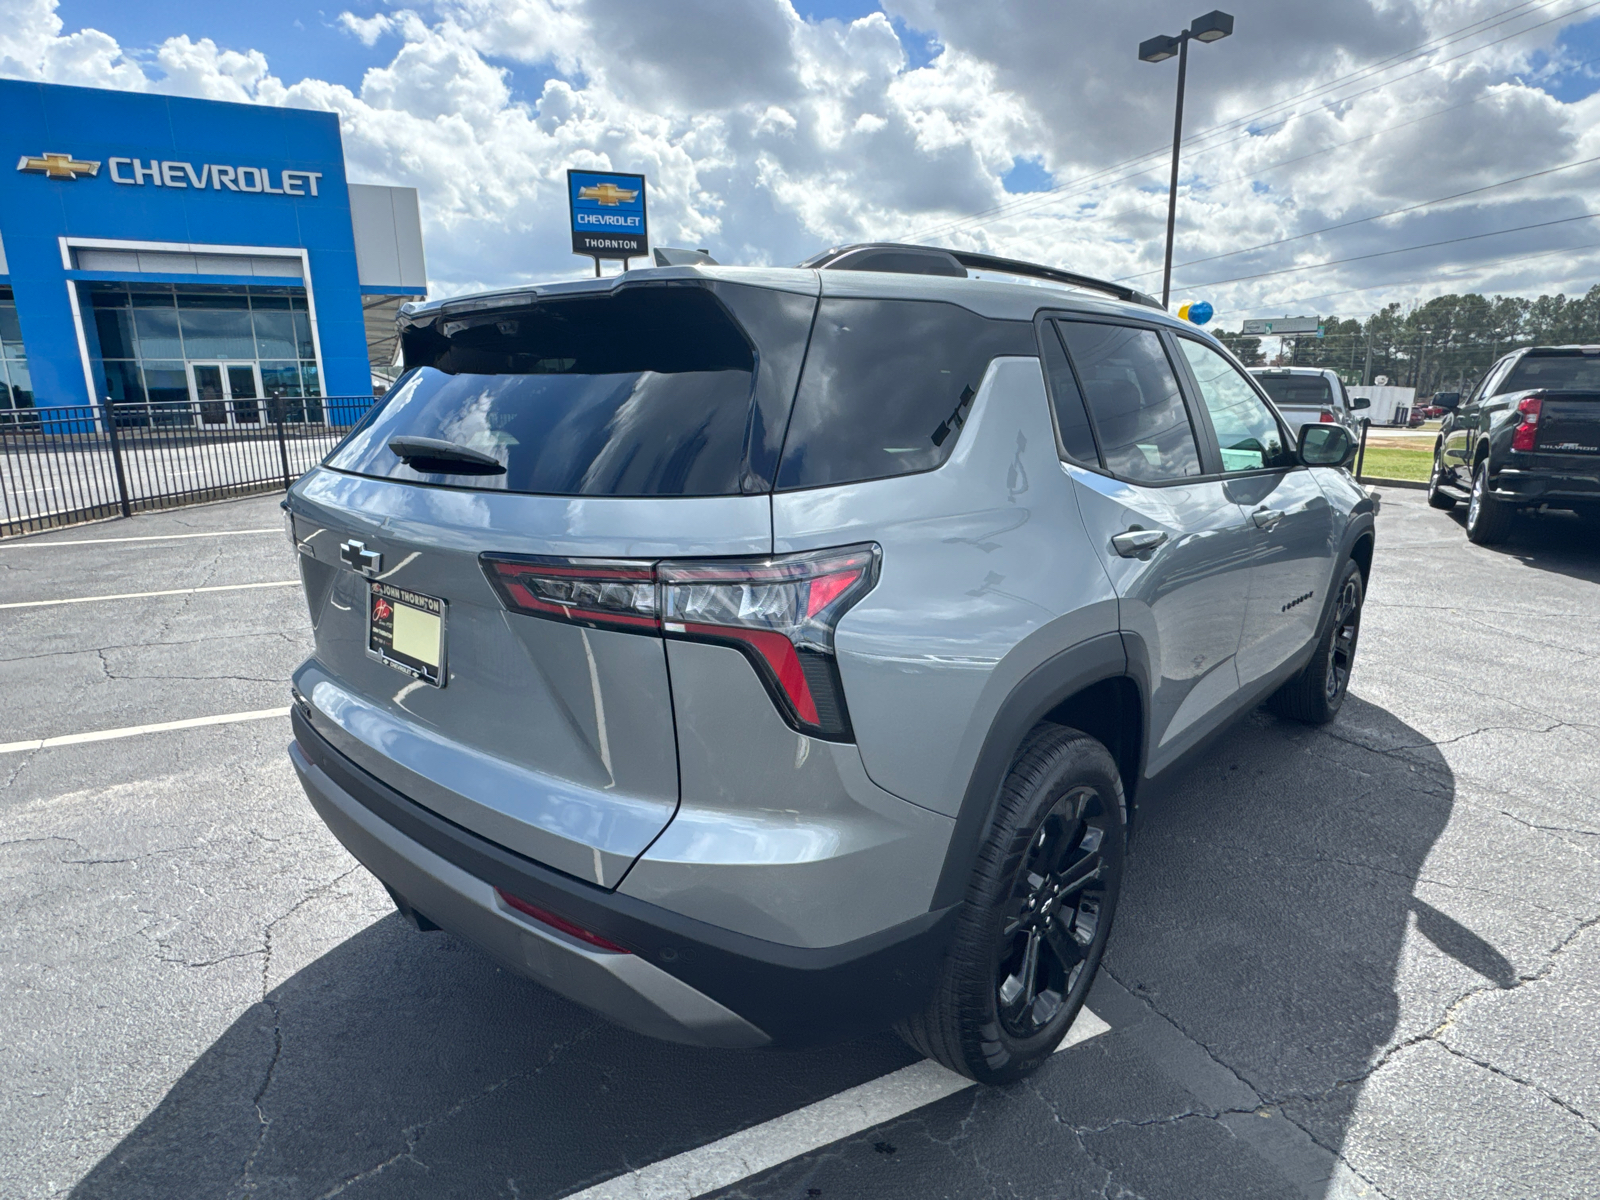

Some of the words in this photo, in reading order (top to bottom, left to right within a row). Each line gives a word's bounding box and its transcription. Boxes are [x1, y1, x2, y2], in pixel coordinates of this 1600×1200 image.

[108, 157, 323, 197] CHEVROLET
[577, 213, 641, 227] CHEVROLET
[584, 238, 638, 250] THORNTON
[383, 585, 400, 599] JOHN
